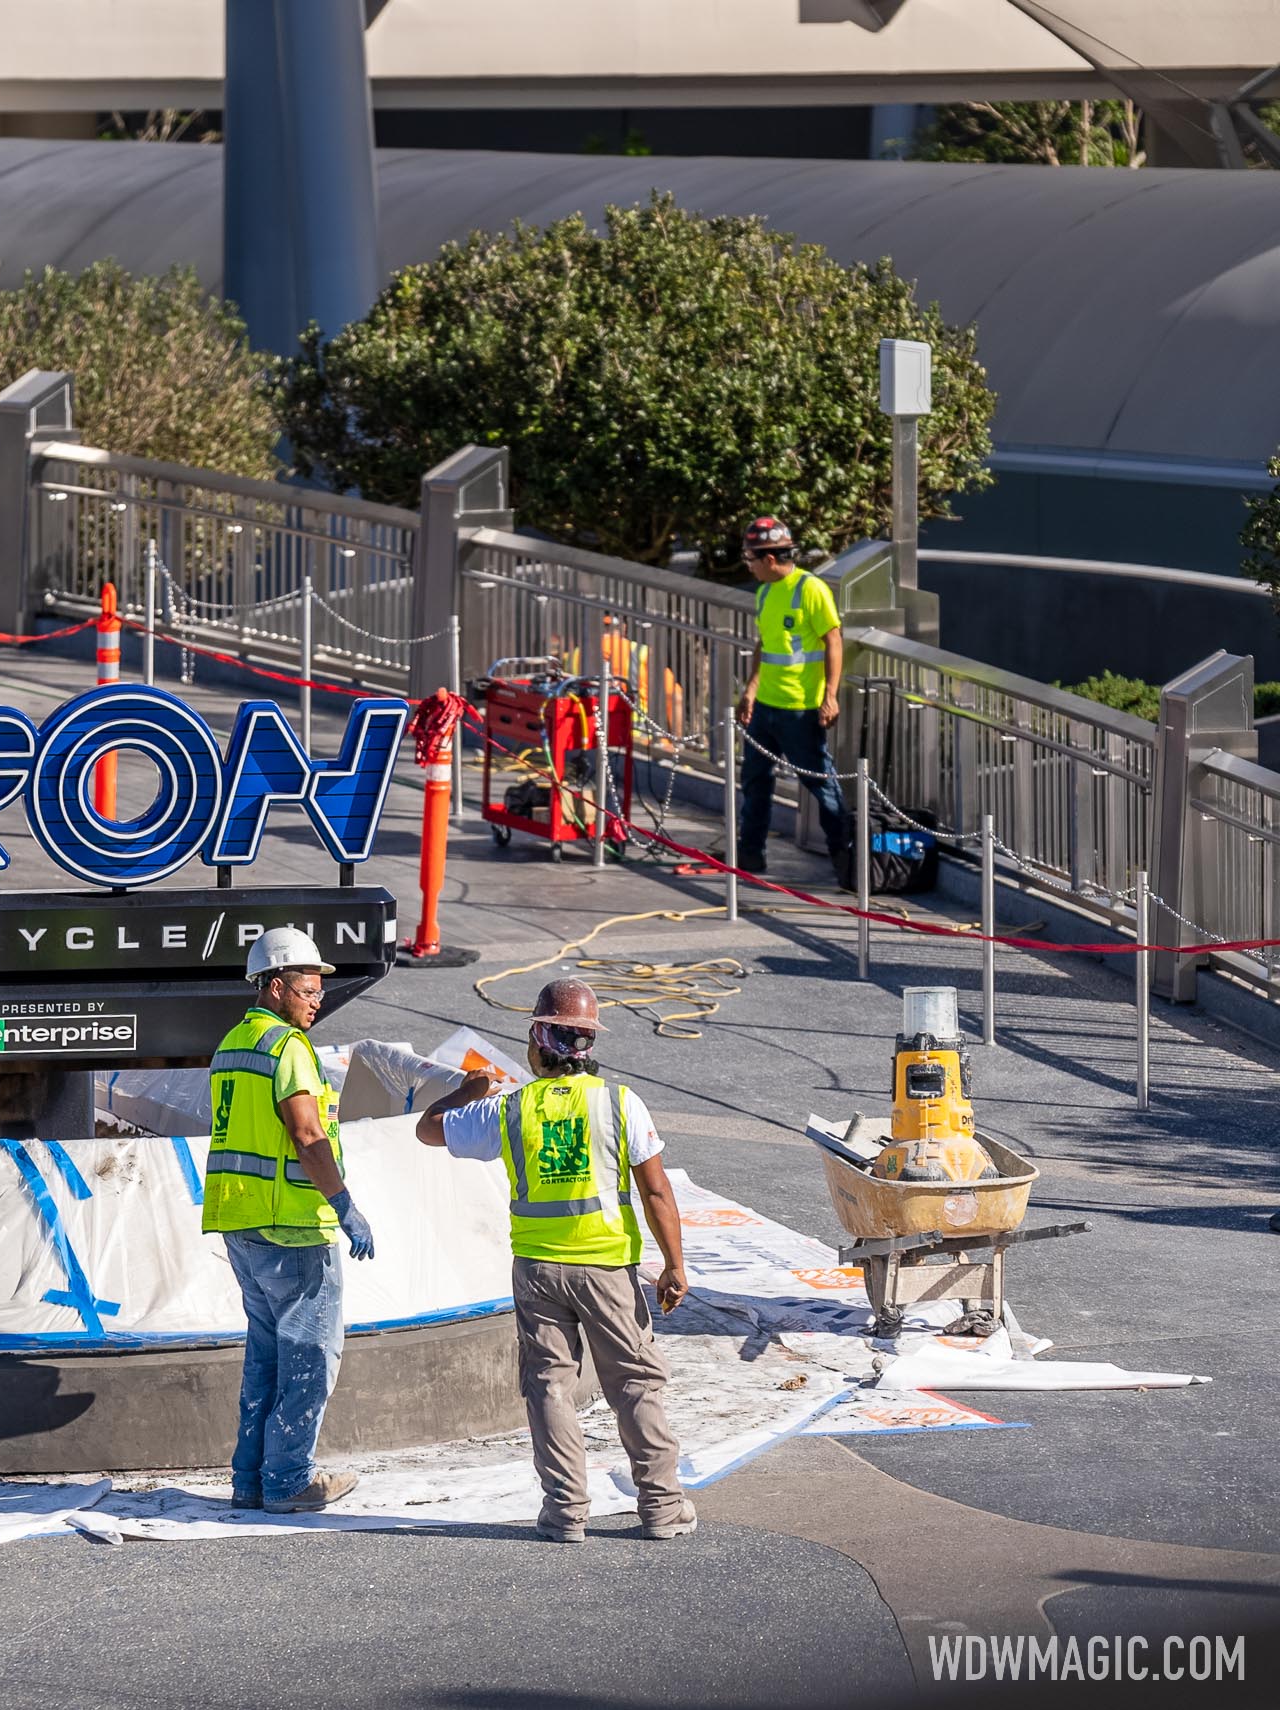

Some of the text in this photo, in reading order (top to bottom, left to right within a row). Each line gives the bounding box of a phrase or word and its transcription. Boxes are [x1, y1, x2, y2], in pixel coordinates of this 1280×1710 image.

[1, 1002, 105, 1014] PRESENTED BY
[540, 1175, 592, 1185] CONTRACTORS
